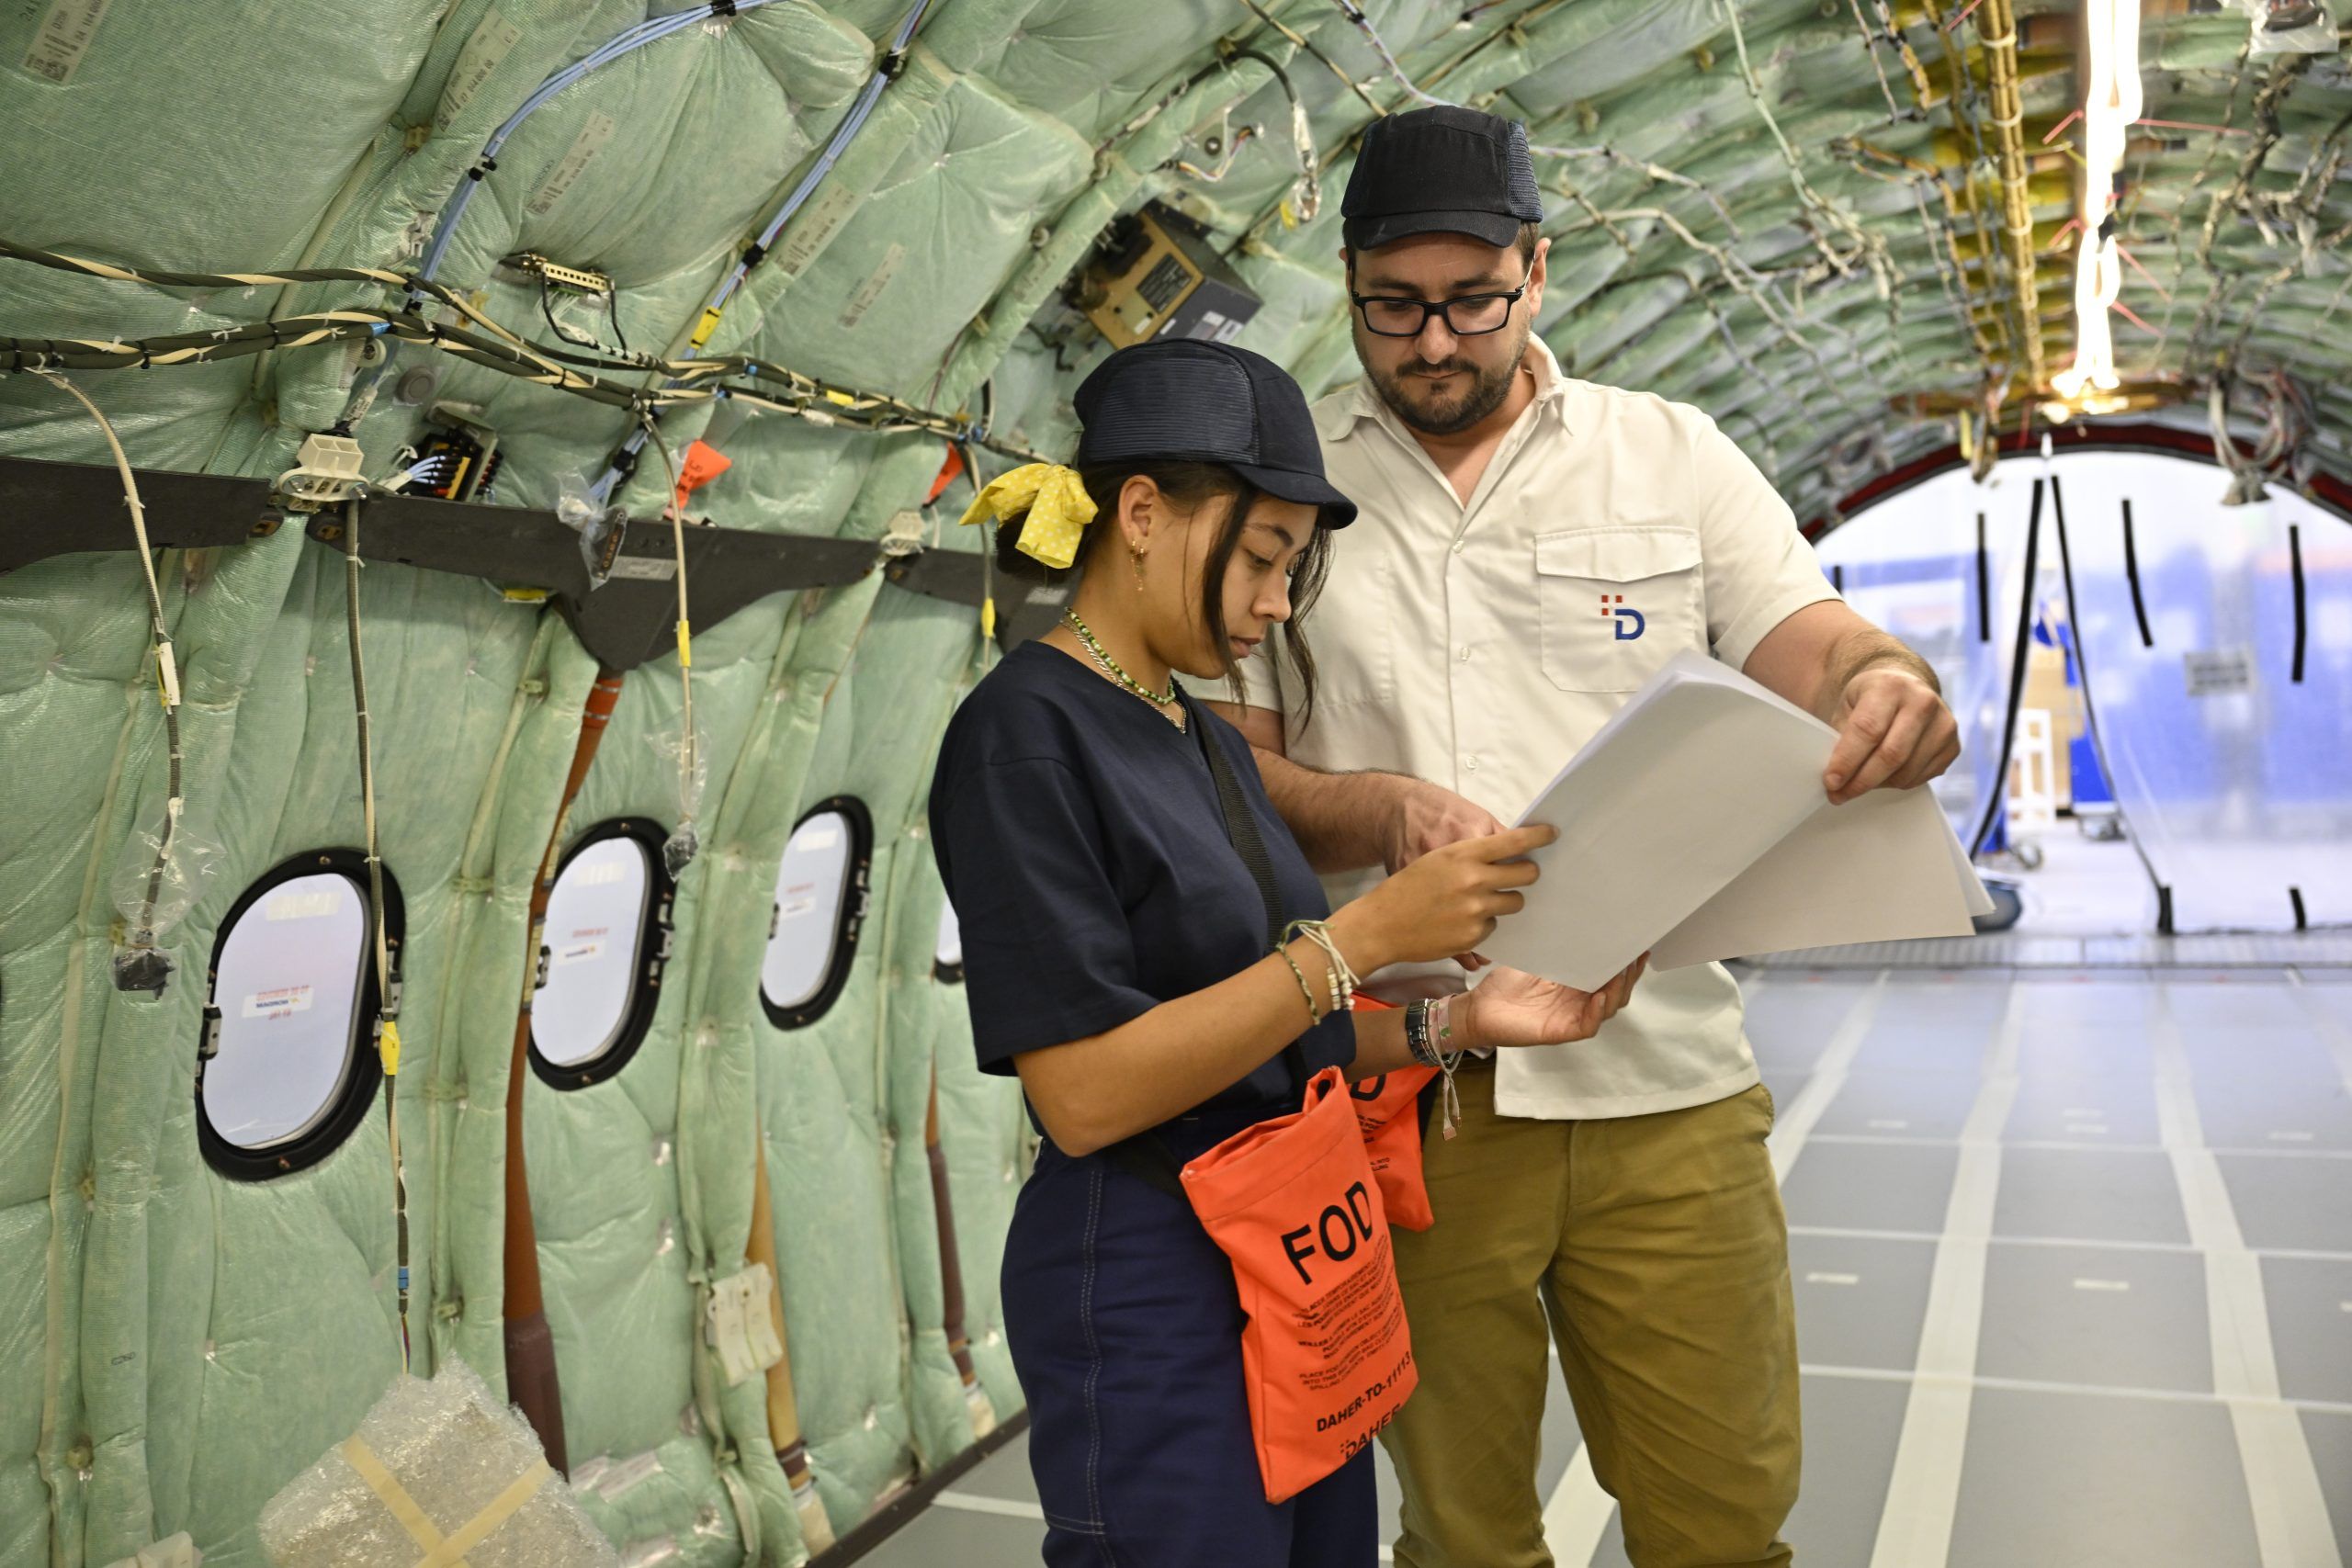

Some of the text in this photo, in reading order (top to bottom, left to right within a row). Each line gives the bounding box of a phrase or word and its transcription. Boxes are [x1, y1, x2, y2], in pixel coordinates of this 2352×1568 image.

[1615, 608, 1645, 640] D
[1281, 1181, 1373, 1285] FOD
[1317, 1350, 1411, 1432] DAHER-TO-11113
